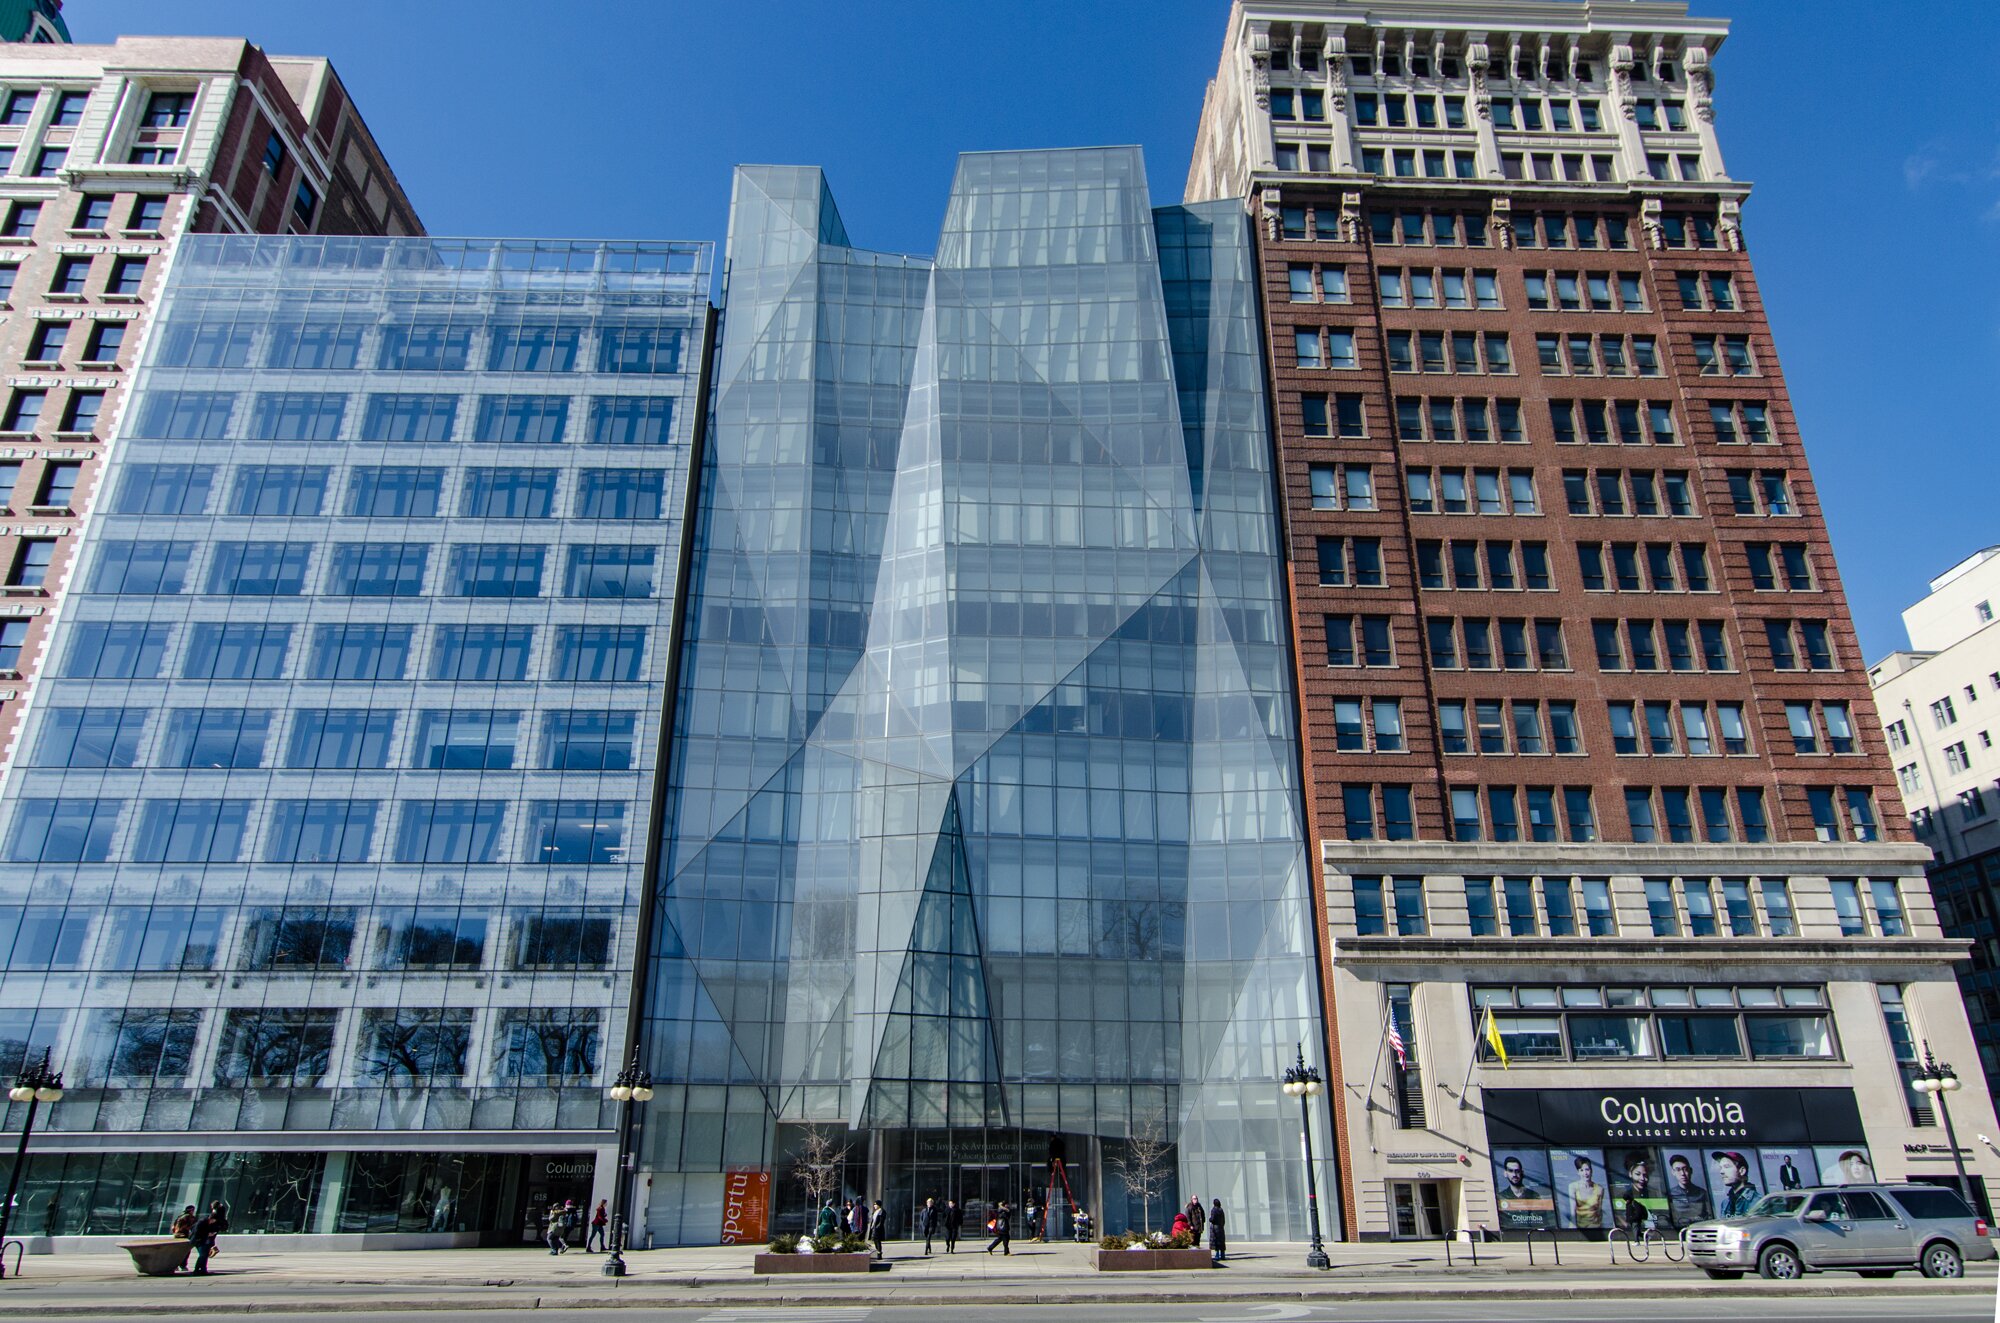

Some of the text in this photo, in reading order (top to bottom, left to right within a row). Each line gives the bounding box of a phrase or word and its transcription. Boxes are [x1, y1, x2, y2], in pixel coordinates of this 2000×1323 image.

[1600, 1096, 1745, 1125] Columbia
[1607, 1129, 1747, 1137] COLLEGE CHICAGO
[919, 1142, 934, 1151] The
[936, 1142, 960, 1152] Joyce
[961, 1142, 970, 1151] &
[1000, 1142, 1019, 1152] Gray
[546, 1162, 593, 1174] Columb
[534, 1193, 548, 1201] 618
[722, 1165, 750, 1244] spertus
[1511, 1213, 1543, 1222] Columbia
